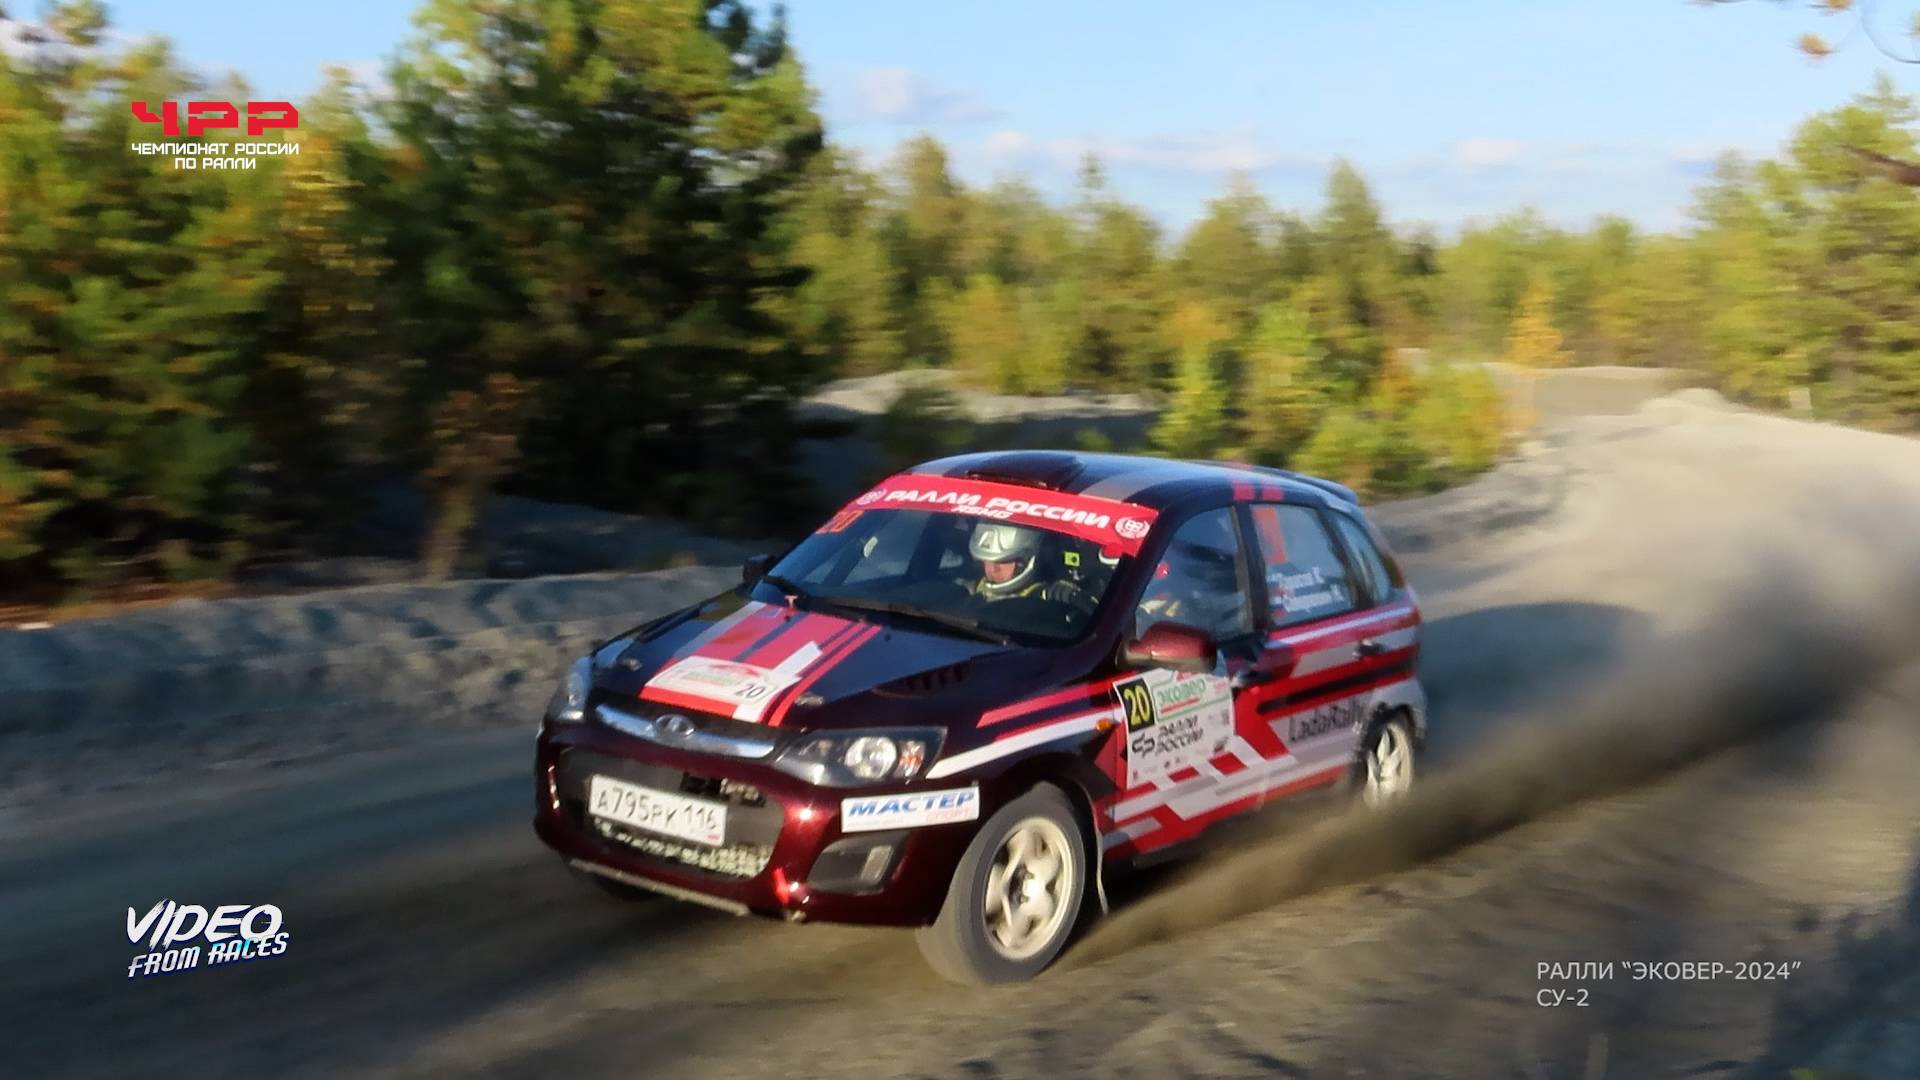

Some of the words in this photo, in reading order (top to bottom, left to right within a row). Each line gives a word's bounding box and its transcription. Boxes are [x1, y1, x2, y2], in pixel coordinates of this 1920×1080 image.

[884, 489, 981, 506] РАЛЛИ
[984, 497, 1111, 529] РОССИИ
[735, 684, 766, 699] 20
[1123, 684, 1151, 726] 20
[848, 791, 976, 816] МАСТЕР
